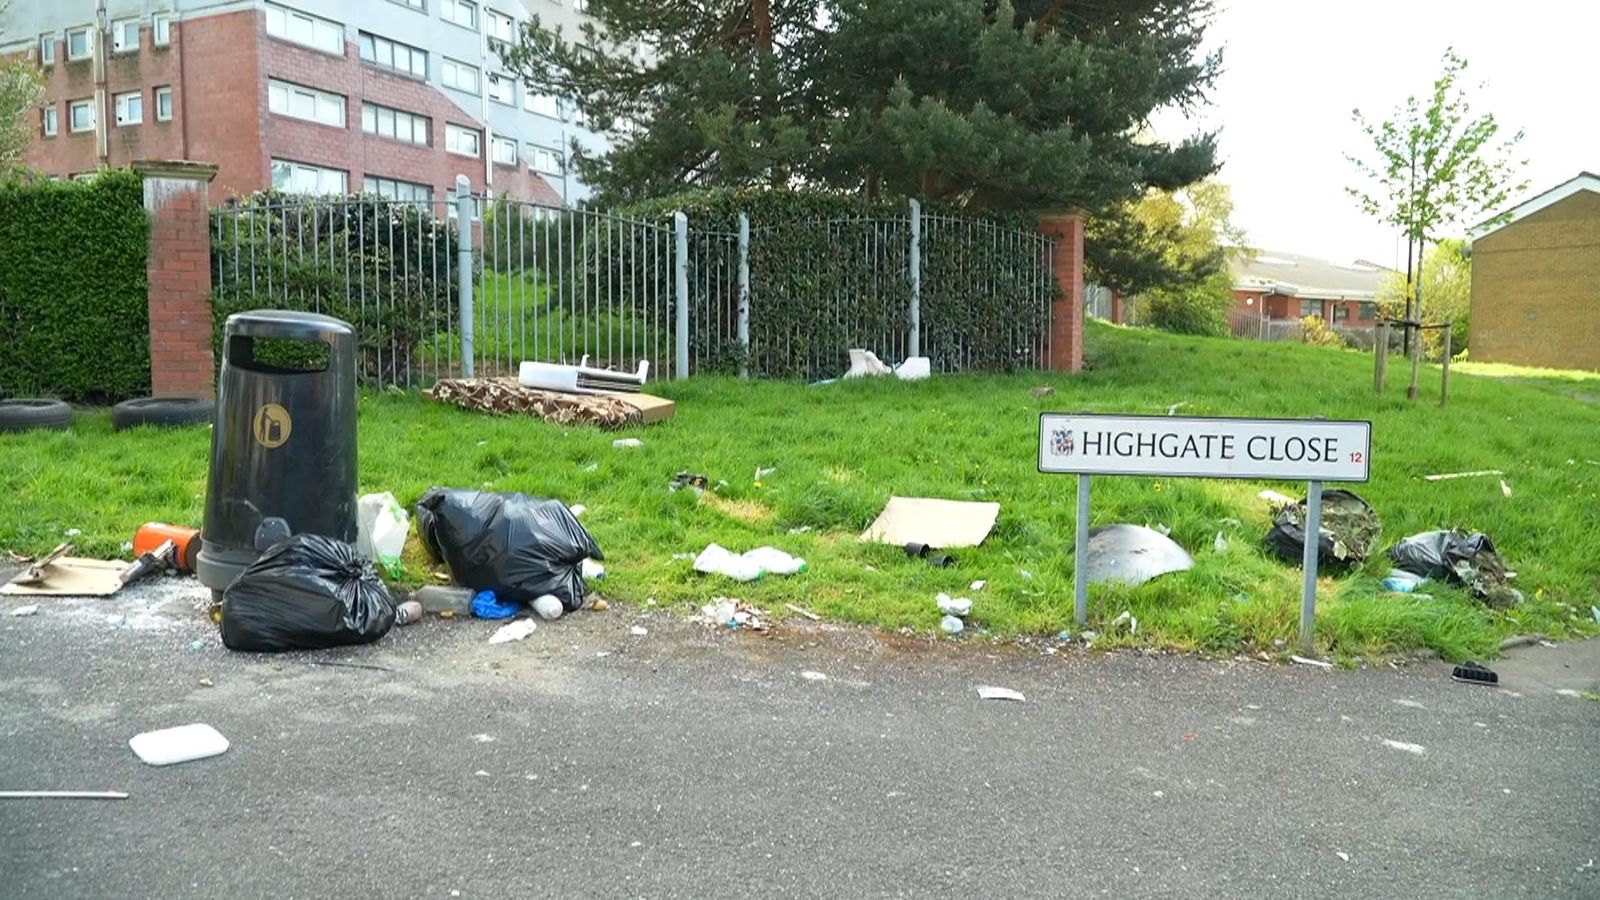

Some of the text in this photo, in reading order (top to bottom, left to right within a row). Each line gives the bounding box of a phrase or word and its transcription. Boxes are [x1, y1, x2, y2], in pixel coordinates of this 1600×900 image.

[1082, 431, 1338, 462] HIGHGATE CLOSE
[1350, 452, 1362, 463] 12
